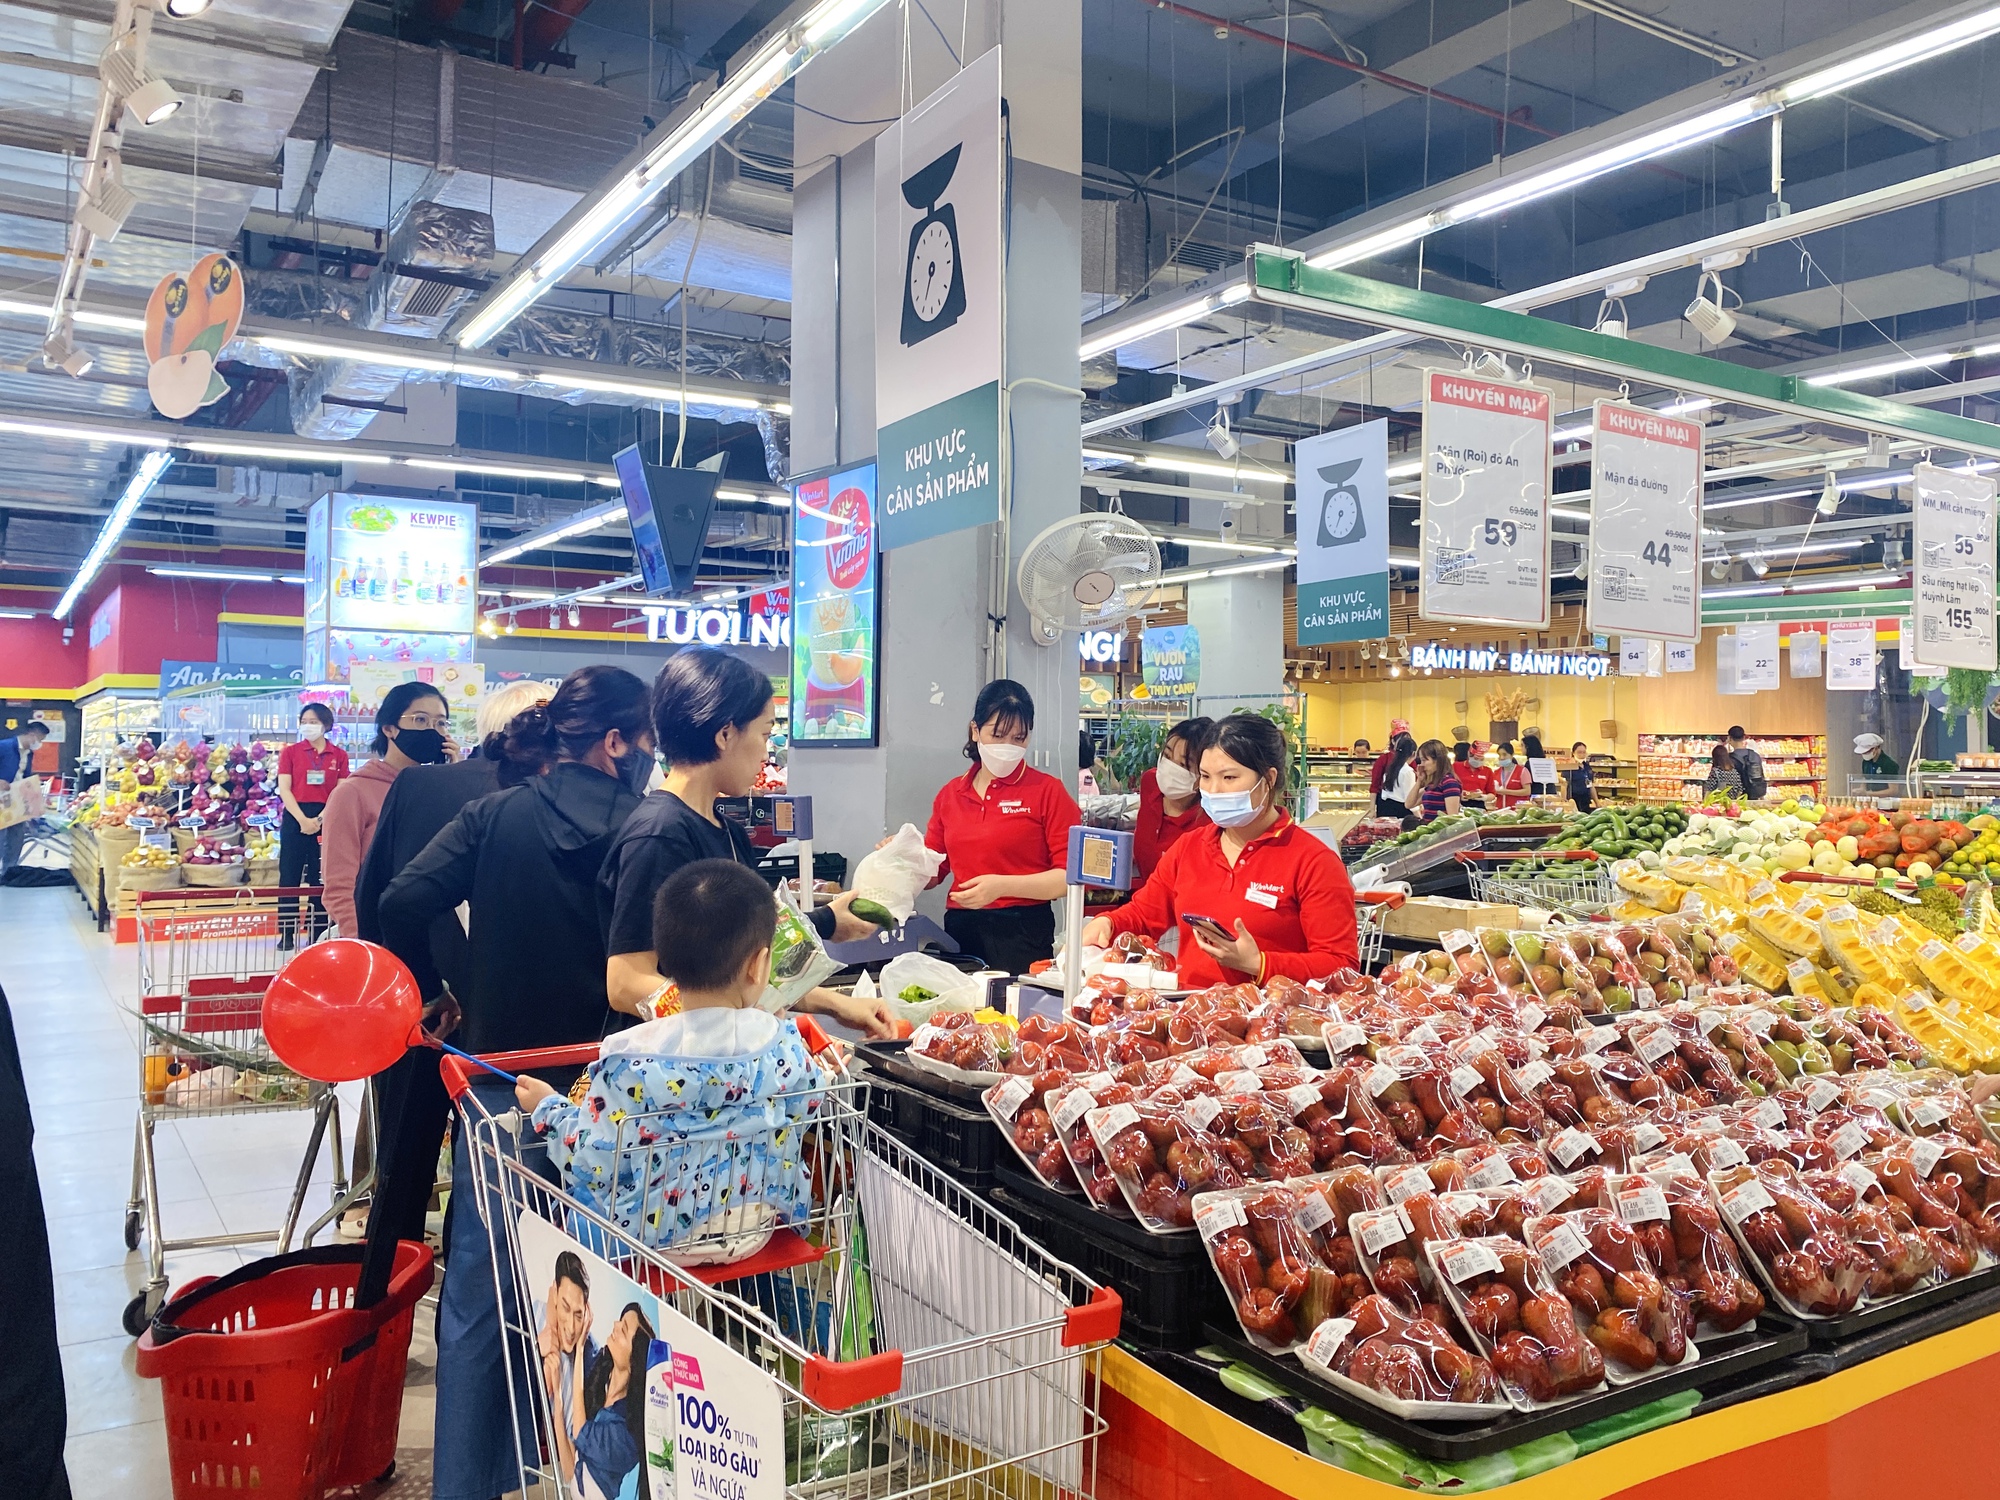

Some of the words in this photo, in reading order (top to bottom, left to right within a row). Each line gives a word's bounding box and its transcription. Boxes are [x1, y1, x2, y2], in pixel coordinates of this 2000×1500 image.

[1442, 382, 1505, 407] KHUYẾN
[1509, 394, 1536, 415] MẠI
[1609, 412, 1662, 437] KHUYẾN
[1665, 425, 1689, 444] MẠI
[905, 441, 932, 472] KHU
[936, 428, 966, 463] VỰC
[1464, 449, 1487, 464] (Roi)
[1505, 455, 1519, 467] An
[886, 484, 913, 516] CÂN
[916, 471, 943, 507] SẢN
[946, 452, 989, 497] PHẨM
[1604, 471, 1625, 486] Mận
[1641, 478, 1668, 495] đường
[410, 512, 456, 526] KEWPIE
[1484, 517, 1517, 547] 59
[1642, 540, 1672, 568] 44
[1955, 533, 1974, 556] 55
[1937, 577, 1955, 591] riêng
[1956, 582, 1967, 593] hạt
[1320, 594, 1341, 608] KHU
[1343, 590, 1366, 607] VỰC
[1922, 590, 1945, 604] Huỳnh
[1946, 593, 1961, 605] Lâm
[641, 606, 741, 646] TƯƠI
[1303, 613, 1325, 628] CÂN
[1327, 608, 1349, 626] SẢN
[1351, 602, 1382, 623] PHẨM
[1946, 607, 1973, 630] 155
[1412, 643, 1466, 669] BÁNH
[1468, 646, 1499, 671] MỲ
[1510, 649, 1561, 675] BÁNH
[1562, 656, 1610, 681] NGỌT
[1628, 652, 1639, 660] 64
[1755, 659, 1767, 668] 22
[1849, 657, 1862, 666] 38
[168, 665, 207, 688] An
[1159, 666, 1183, 682] RAU
[1173, 682, 1196, 696] CANH
[202, 927, 252, 938] Promotion
[677, 1392, 731, 1440] 100%
[734, 1430, 744, 1448] TỰ
[745, 1434, 758, 1449] TIN
[680, 1434, 706, 1464] LOẠI
[710, 1442, 727, 1467] BỎ
[691, 1466, 707, 1491] VÀ
